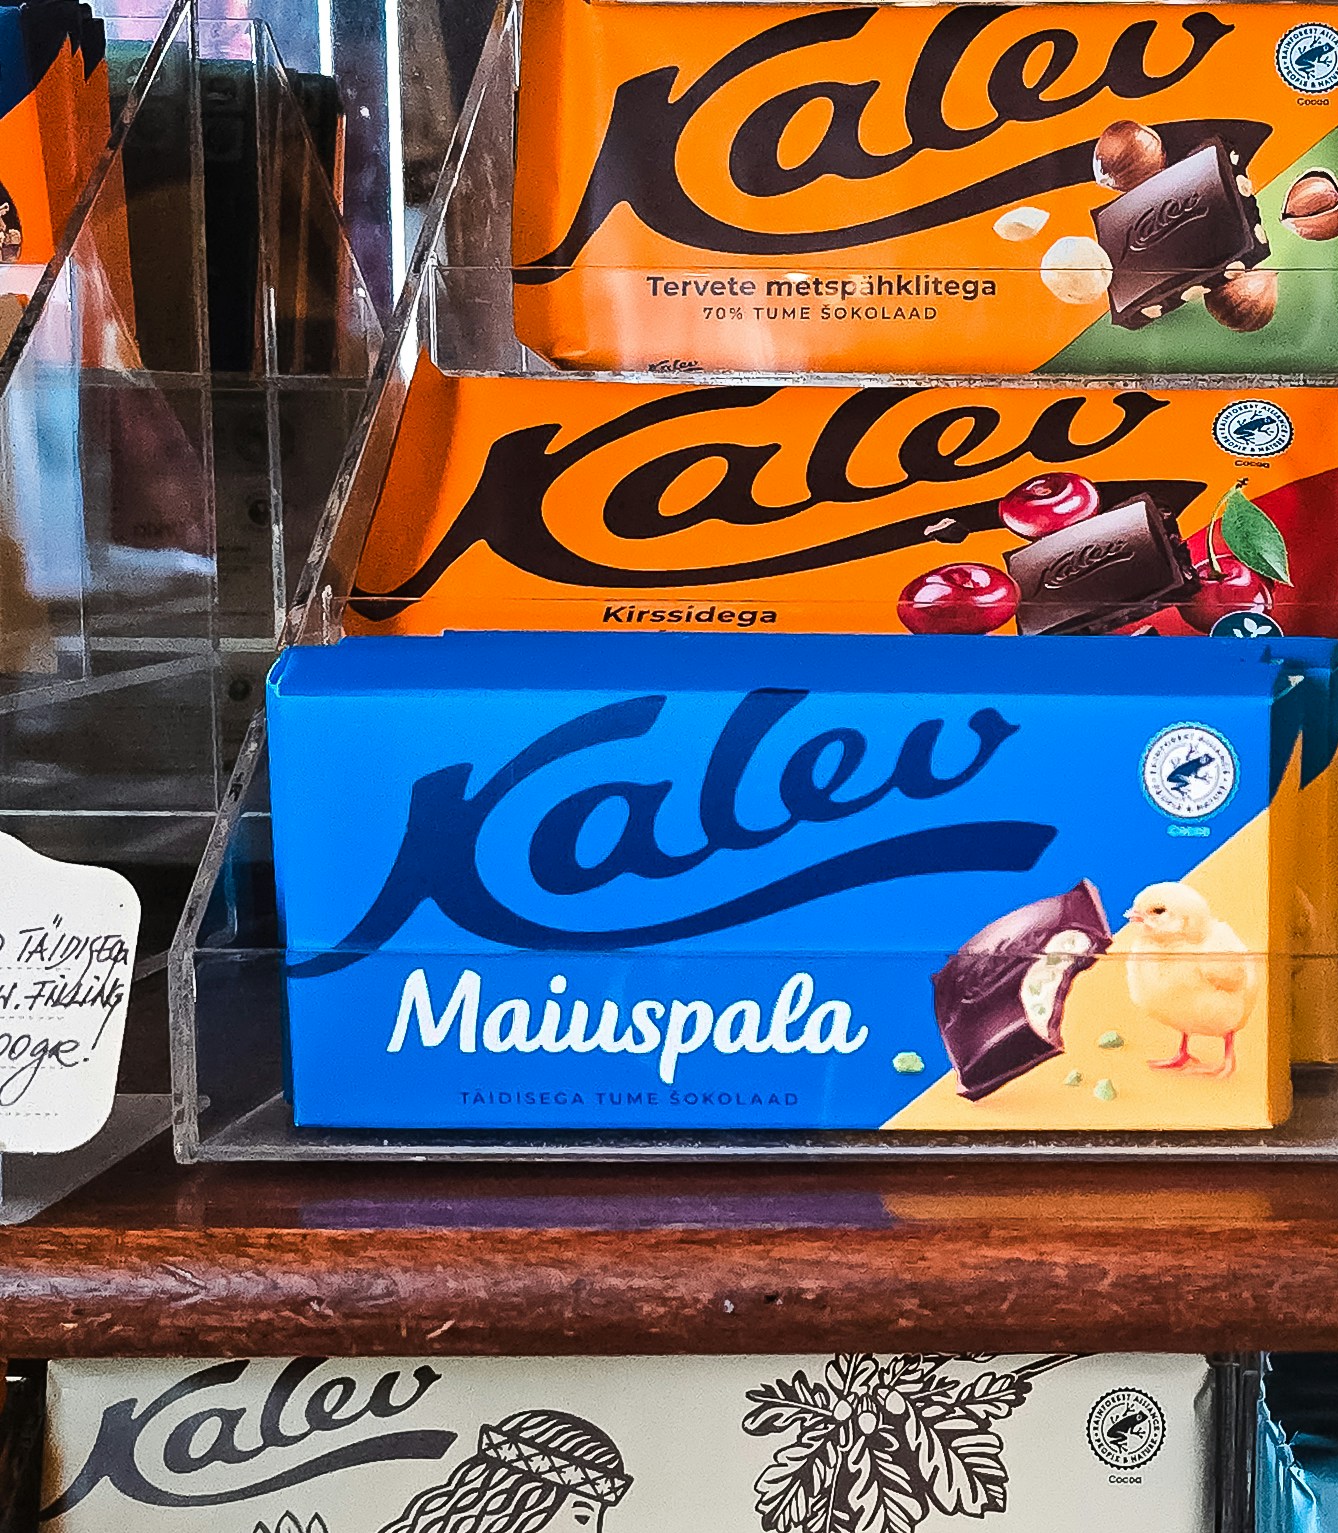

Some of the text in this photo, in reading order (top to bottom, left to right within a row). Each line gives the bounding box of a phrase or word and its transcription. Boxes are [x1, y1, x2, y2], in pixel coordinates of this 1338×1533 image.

[512, 5, 1273, 285] Kalev
[646, 274, 997, 301] Tervete metspähklitega
[703, 302, 938, 320] 70% TUME ŠOKOLAAD
[352, 386, 1207, 621] Kalev
[602, 605, 778, 628] Kirssidega
[286, 687, 1058, 979] Kalev
[387, 968, 868, 1084] Maiuspala
[459, 1088, 799, 1105] TÄIDISEGA TUME ŠOKOLAAD
[40, 1359, 457, 1521] Kalev
[1108, 1475, 1142, 1484] Cocoa
